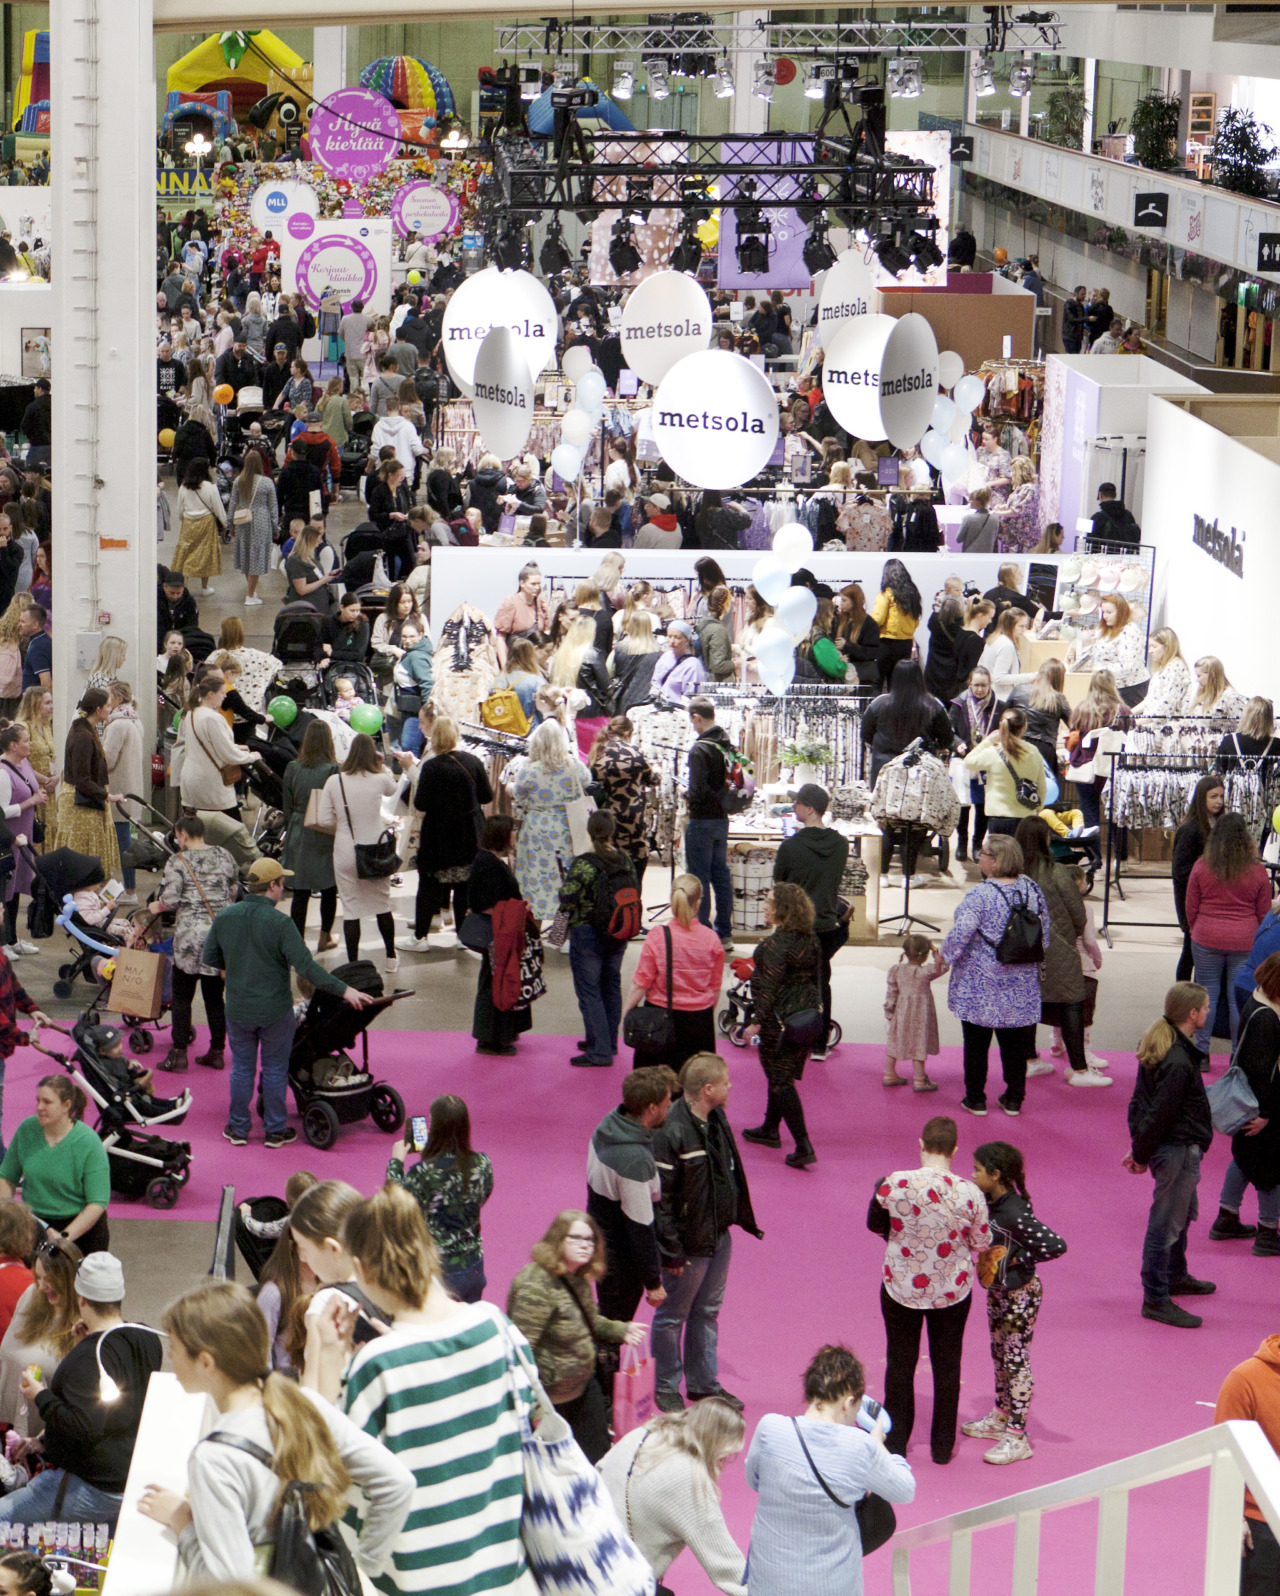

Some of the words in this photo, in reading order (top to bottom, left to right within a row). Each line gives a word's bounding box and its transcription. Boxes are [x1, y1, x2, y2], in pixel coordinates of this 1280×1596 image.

[328, 112, 382, 139] Hyvä
[325, 135, 385, 151] kiertää
[267, 198, 287, 207] MLL
[821, 298, 868, 321] metsola
[625, 319, 702, 341] metsola
[827, 369, 880, 388] mets
[881, 368, 933, 397] metsola
[474, 381, 527, 409] metsola
[658, 410, 766, 435] metsola
[1192, 512, 1244, 580] metsola
